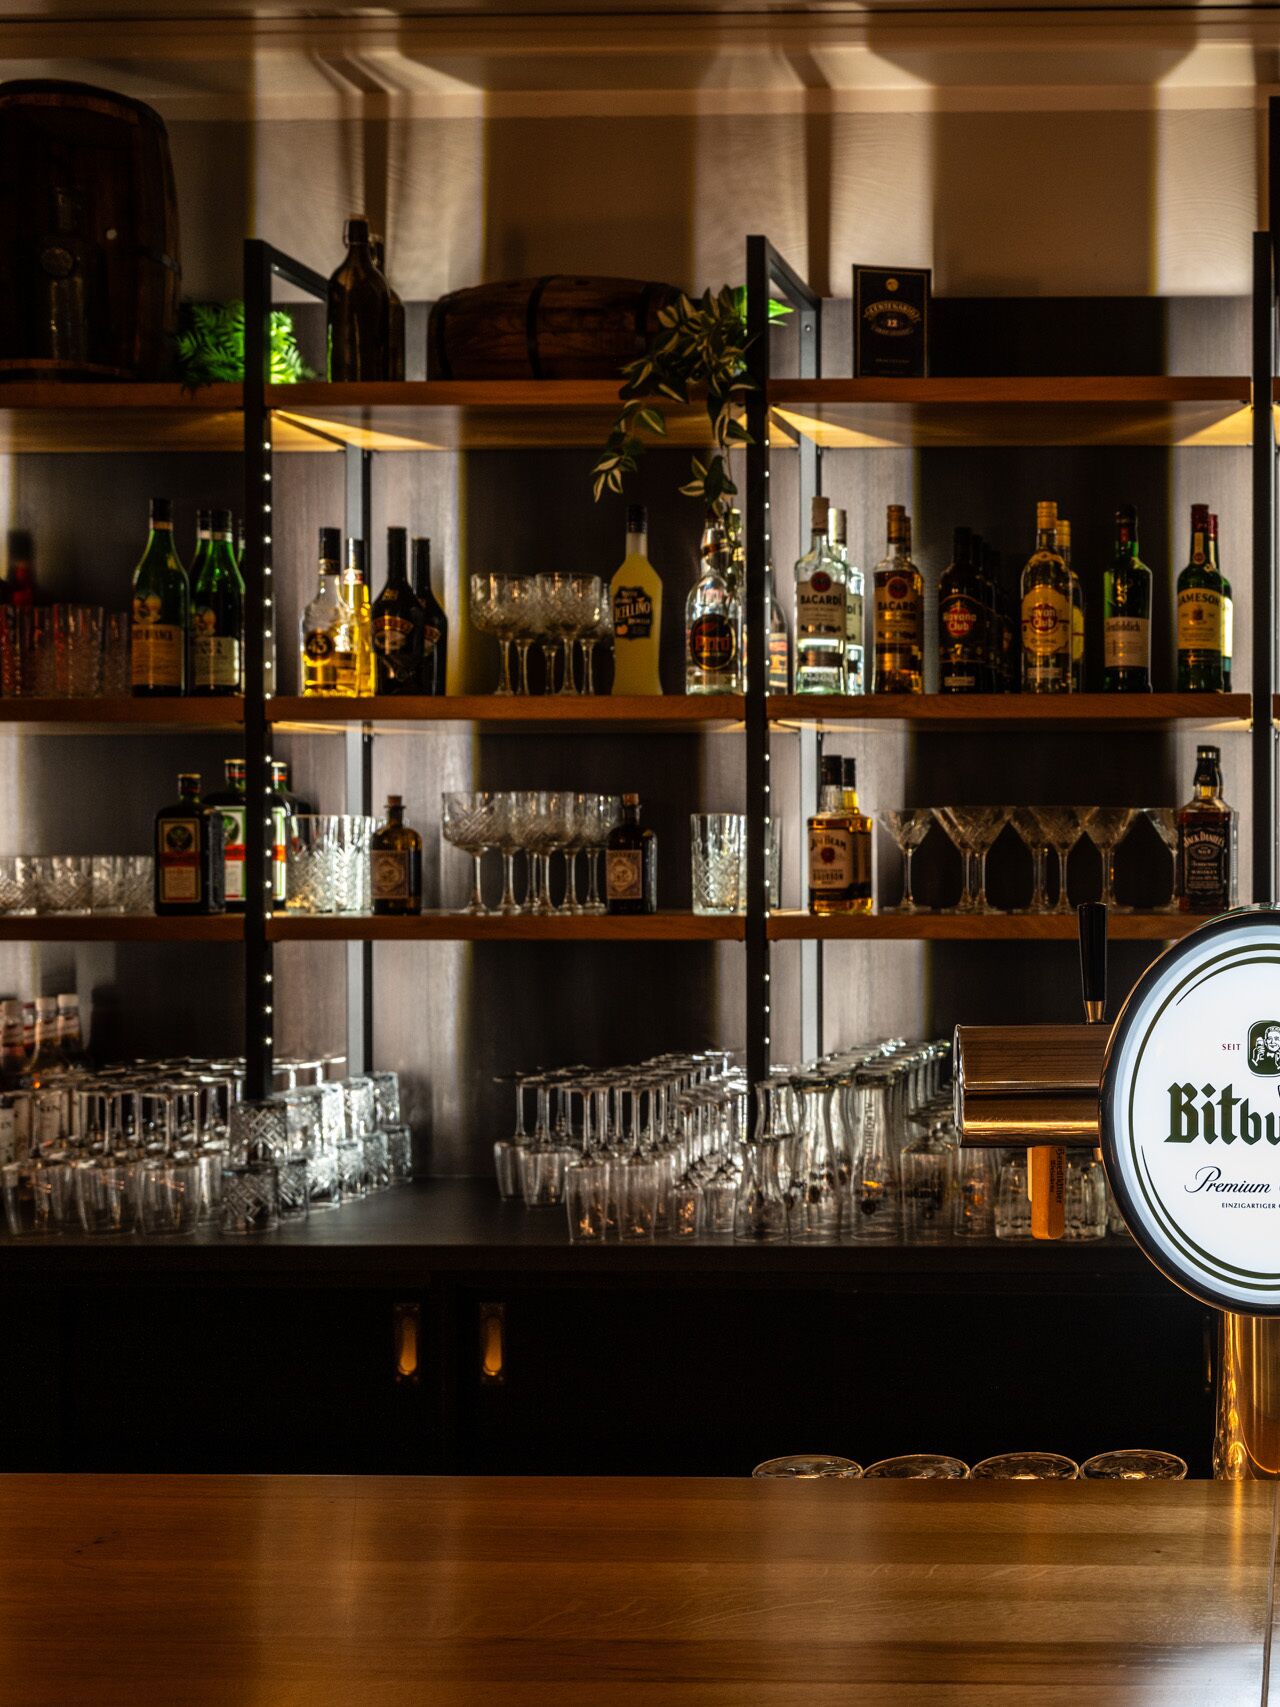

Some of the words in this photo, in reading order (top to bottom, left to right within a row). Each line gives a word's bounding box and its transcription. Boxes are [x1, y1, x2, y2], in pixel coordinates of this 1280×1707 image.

[800, 593, 842, 606] BACARDÍ
[947, 621, 969, 631] Club
[954, 643, 963, 655] 7
[1221, 1043, 1241, 1051] SEIT
[1184, 1165, 1271, 1194] Premium
